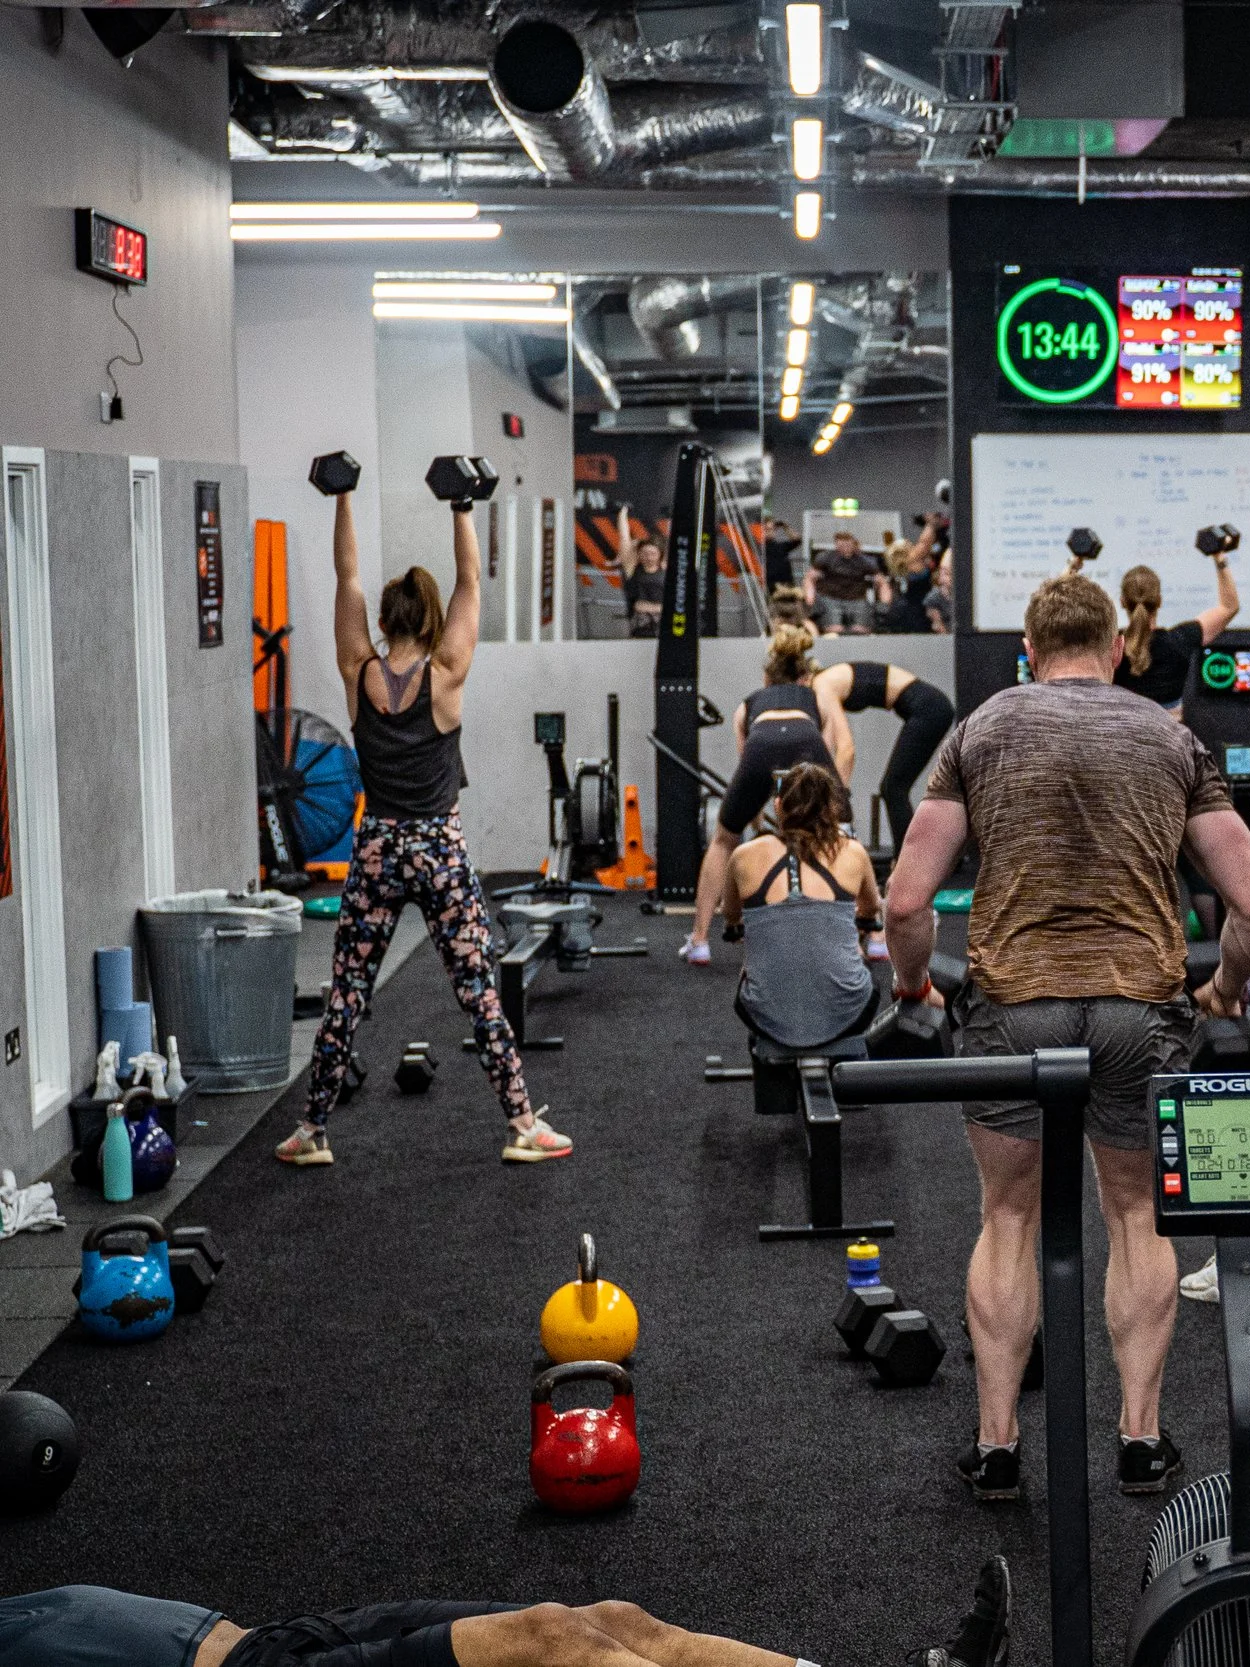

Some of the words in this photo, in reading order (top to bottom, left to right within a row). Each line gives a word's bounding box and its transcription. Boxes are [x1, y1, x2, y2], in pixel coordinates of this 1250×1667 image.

[1132, 299, 1172, 321] 90%
[1194, 300, 1235, 322] 90%
[1017, 321, 1100, 360] 13:44
[1131, 362, 1172, 384] 91%
[1239, 1132, 1248, 1144] 0
[43, 1445, 55, 1462] 9
